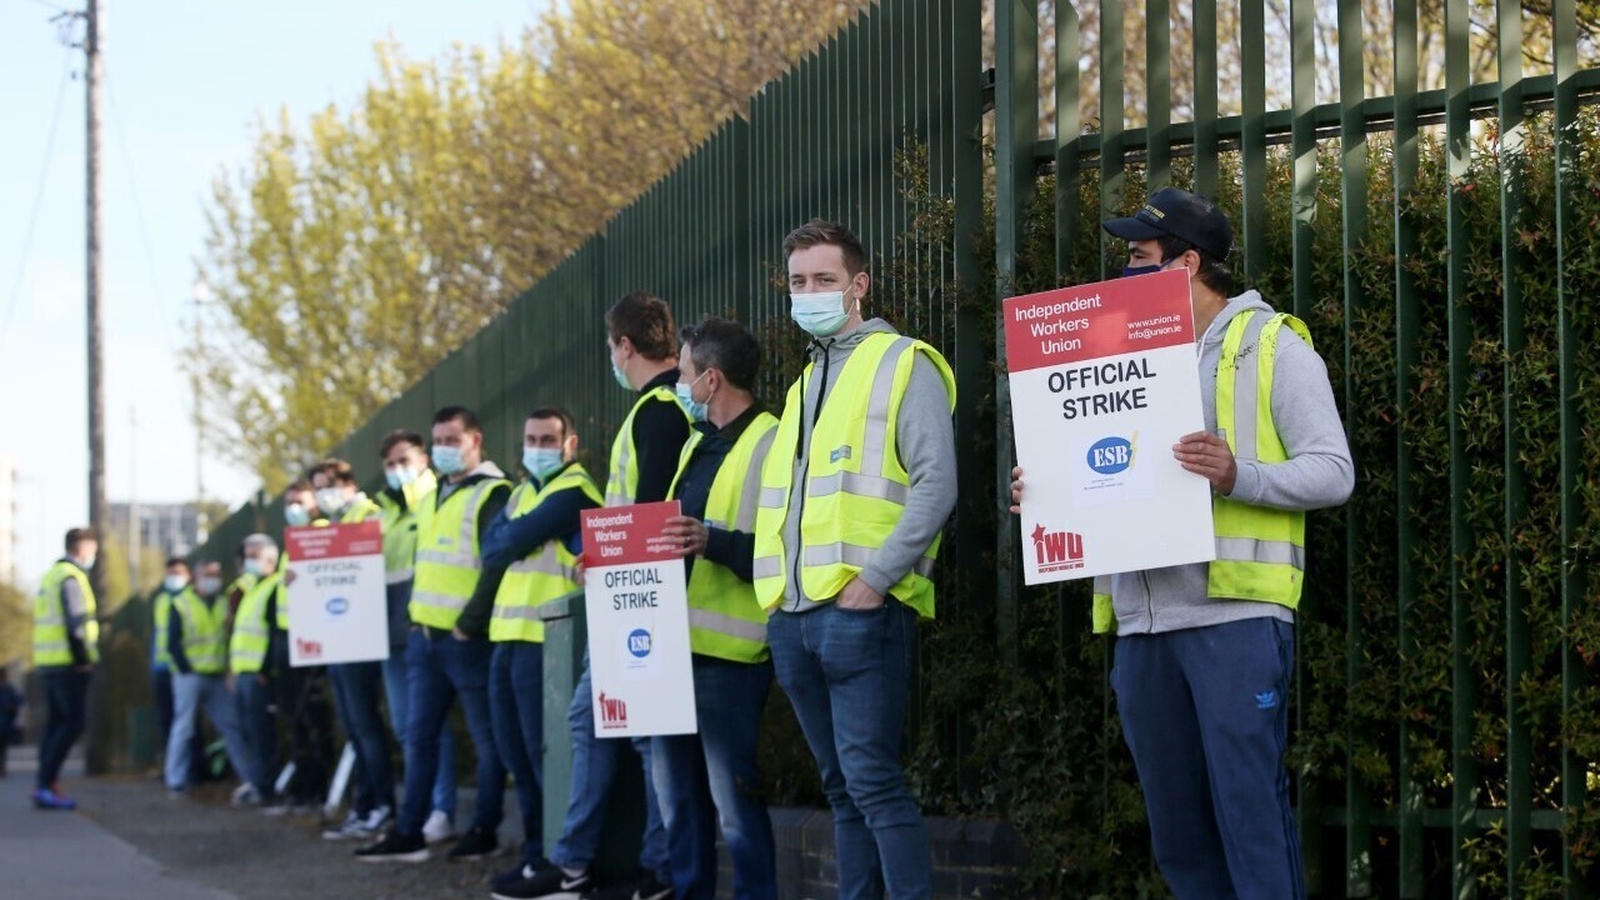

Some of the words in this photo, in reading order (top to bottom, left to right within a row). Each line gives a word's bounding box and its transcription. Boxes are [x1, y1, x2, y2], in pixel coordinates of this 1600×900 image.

[1015, 294, 1102, 321] Independent
[1030, 318, 1090, 338] Workers
[1127, 313, 1181, 329] www.union.ie
[1128, 324, 1182, 341] info@union.ie
[1041, 337, 1082, 355] Union
[1048, 358, 1157, 393] OFFICIAL
[1062, 387, 1148, 420] STRIKE
[1093, 445, 1129, 468] ESB
[586, 512, 634, 529] Independent
[594, 530, 628, 543] Workers
[600, 545, 623, 558] Union
[605, 568, 663, 588] OFFICIAL
[613, 591, 659, 611] STRIKE
[630, 635, 650, 652] ESB
